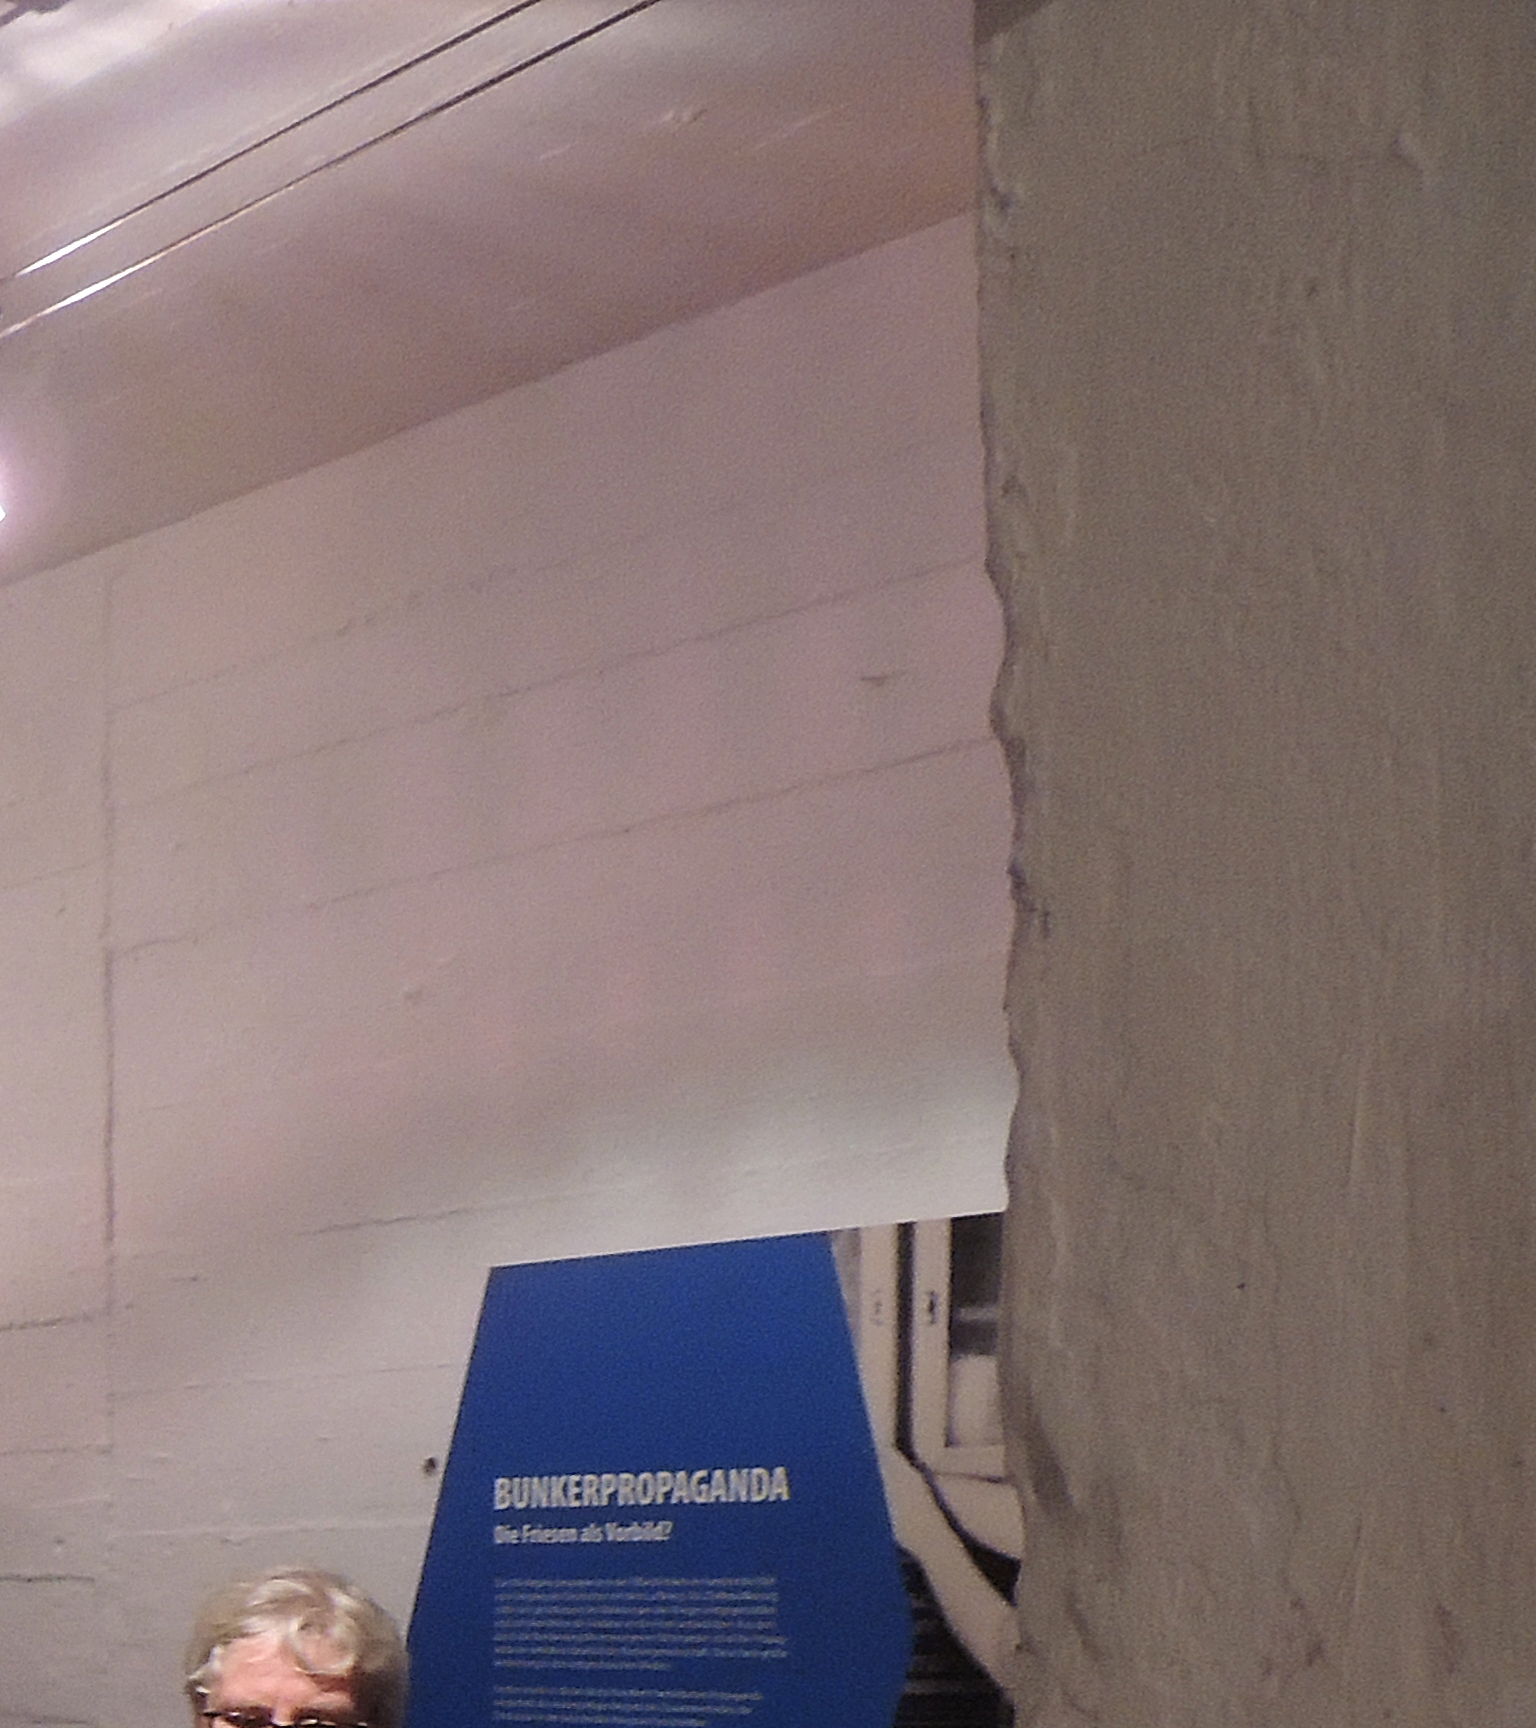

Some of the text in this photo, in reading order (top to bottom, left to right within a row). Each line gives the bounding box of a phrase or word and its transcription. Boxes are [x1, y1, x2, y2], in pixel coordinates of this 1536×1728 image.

[493, 1466, 791, 1510] BUNKERPROPAGANDA
[494, 1524, 520, 1544] Die
[580, 1522, 604, 1543] als
[606, 1521, 674, 1542] Vorbild?
